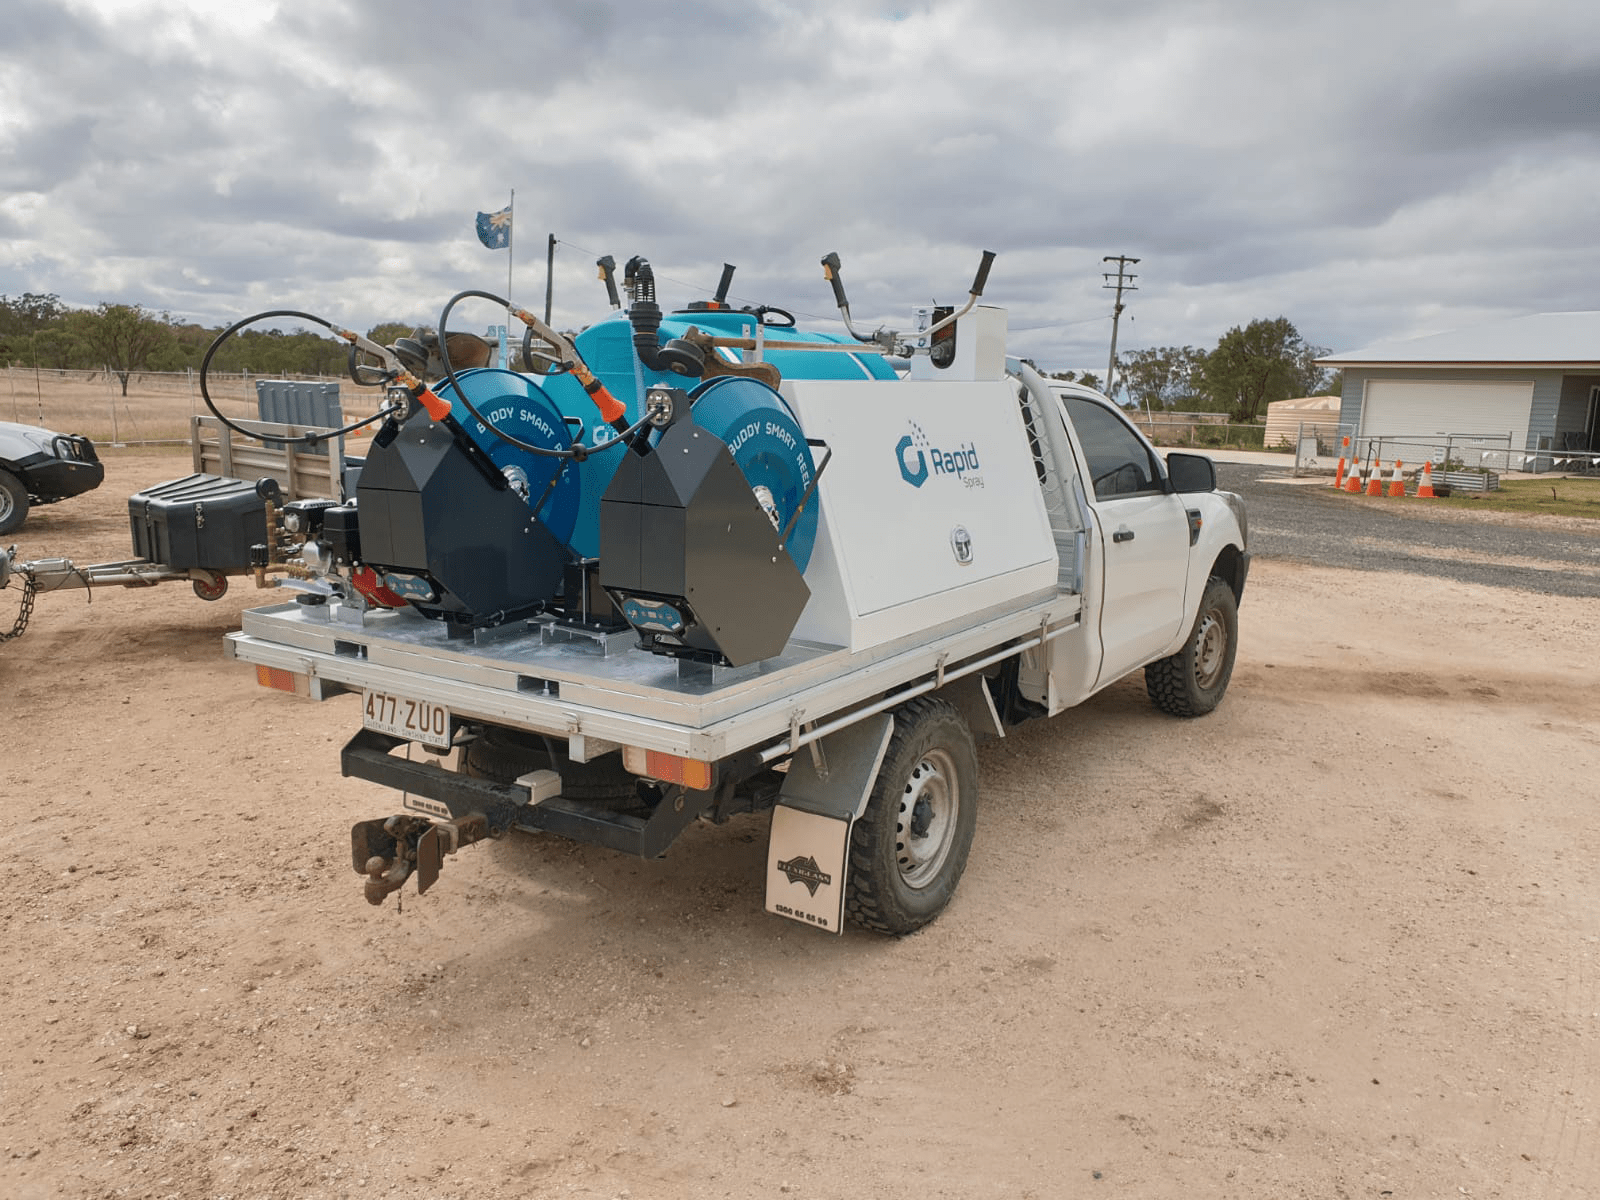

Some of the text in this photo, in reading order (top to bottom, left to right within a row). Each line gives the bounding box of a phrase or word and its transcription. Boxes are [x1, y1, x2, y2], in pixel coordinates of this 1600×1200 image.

[520, 409, 555, 439] SMART
[728, 421, 810, 491] BUDDY SMART REEL
[930, 442, 979, 480] Rapid
[963, 476, 985, 489] Spray
[366, 692, 445, 736] 477 ZUO
[776, 904, 793, 915] 1300
